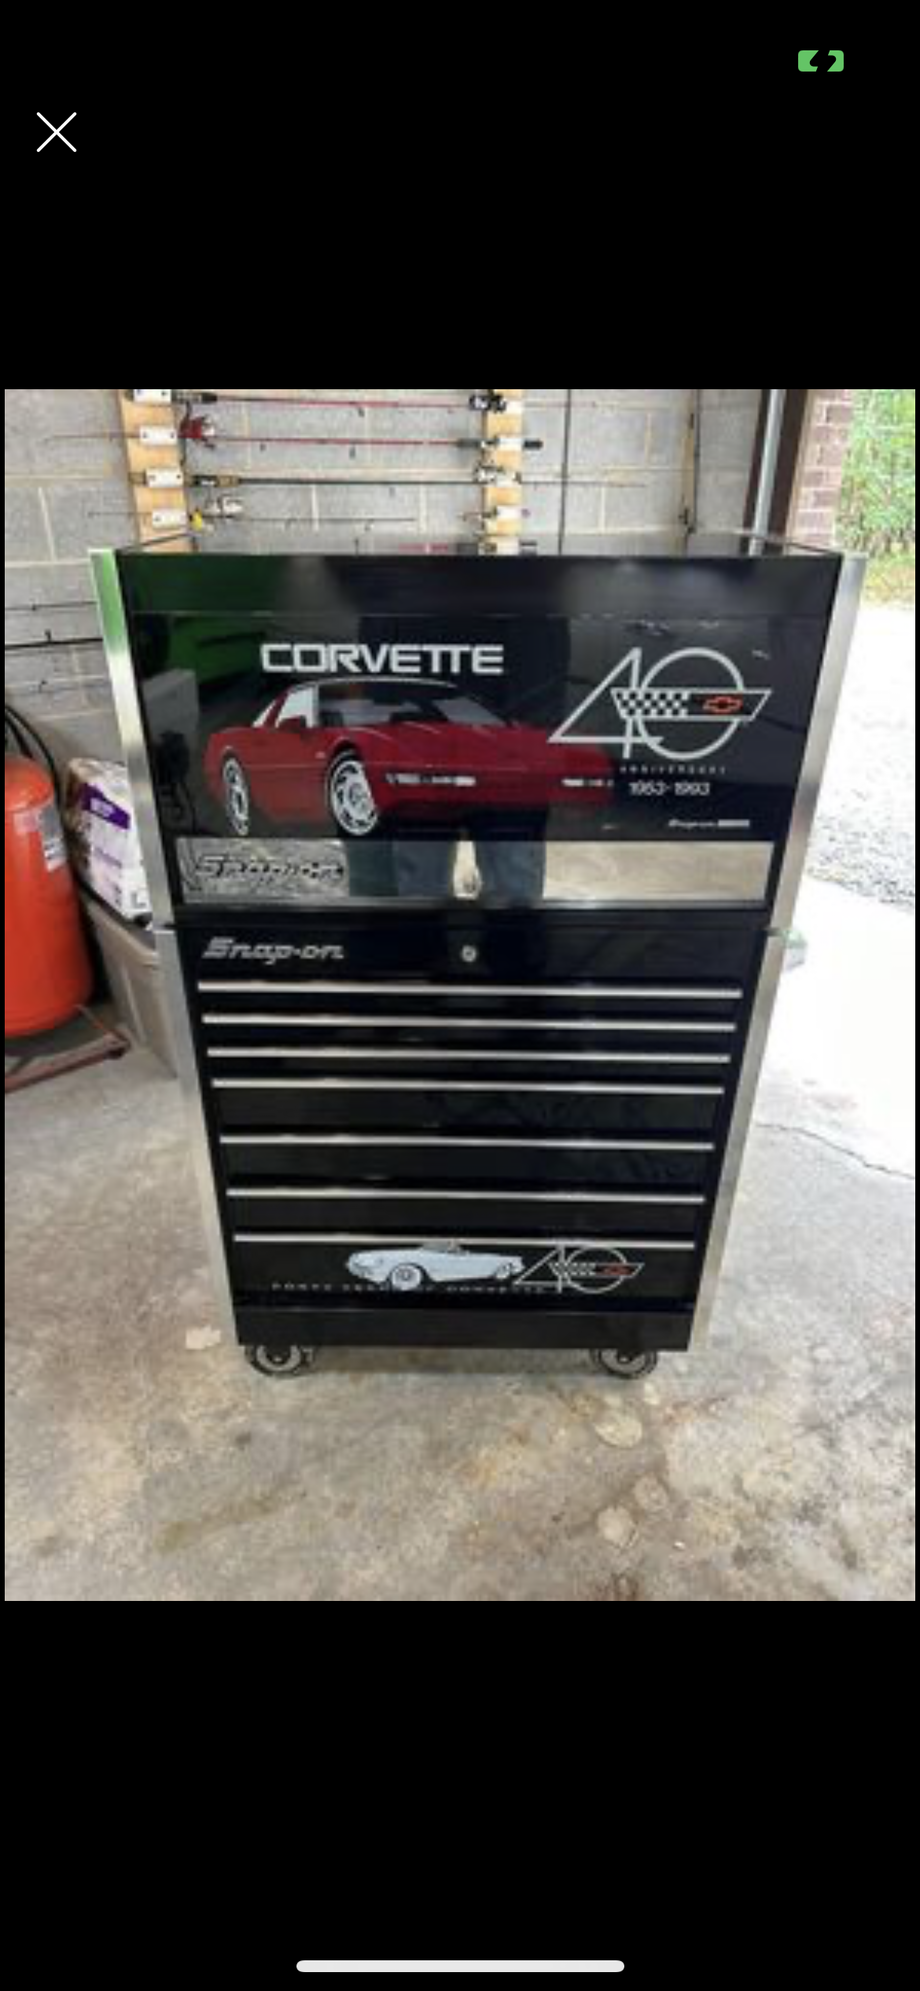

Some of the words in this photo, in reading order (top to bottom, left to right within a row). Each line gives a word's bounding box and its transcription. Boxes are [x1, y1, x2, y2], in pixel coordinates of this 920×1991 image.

[260, 643, 504, 674] CORVETTE
[547, 647, 747, 760] 40
[202, 936, 344, 965] Snap-on
